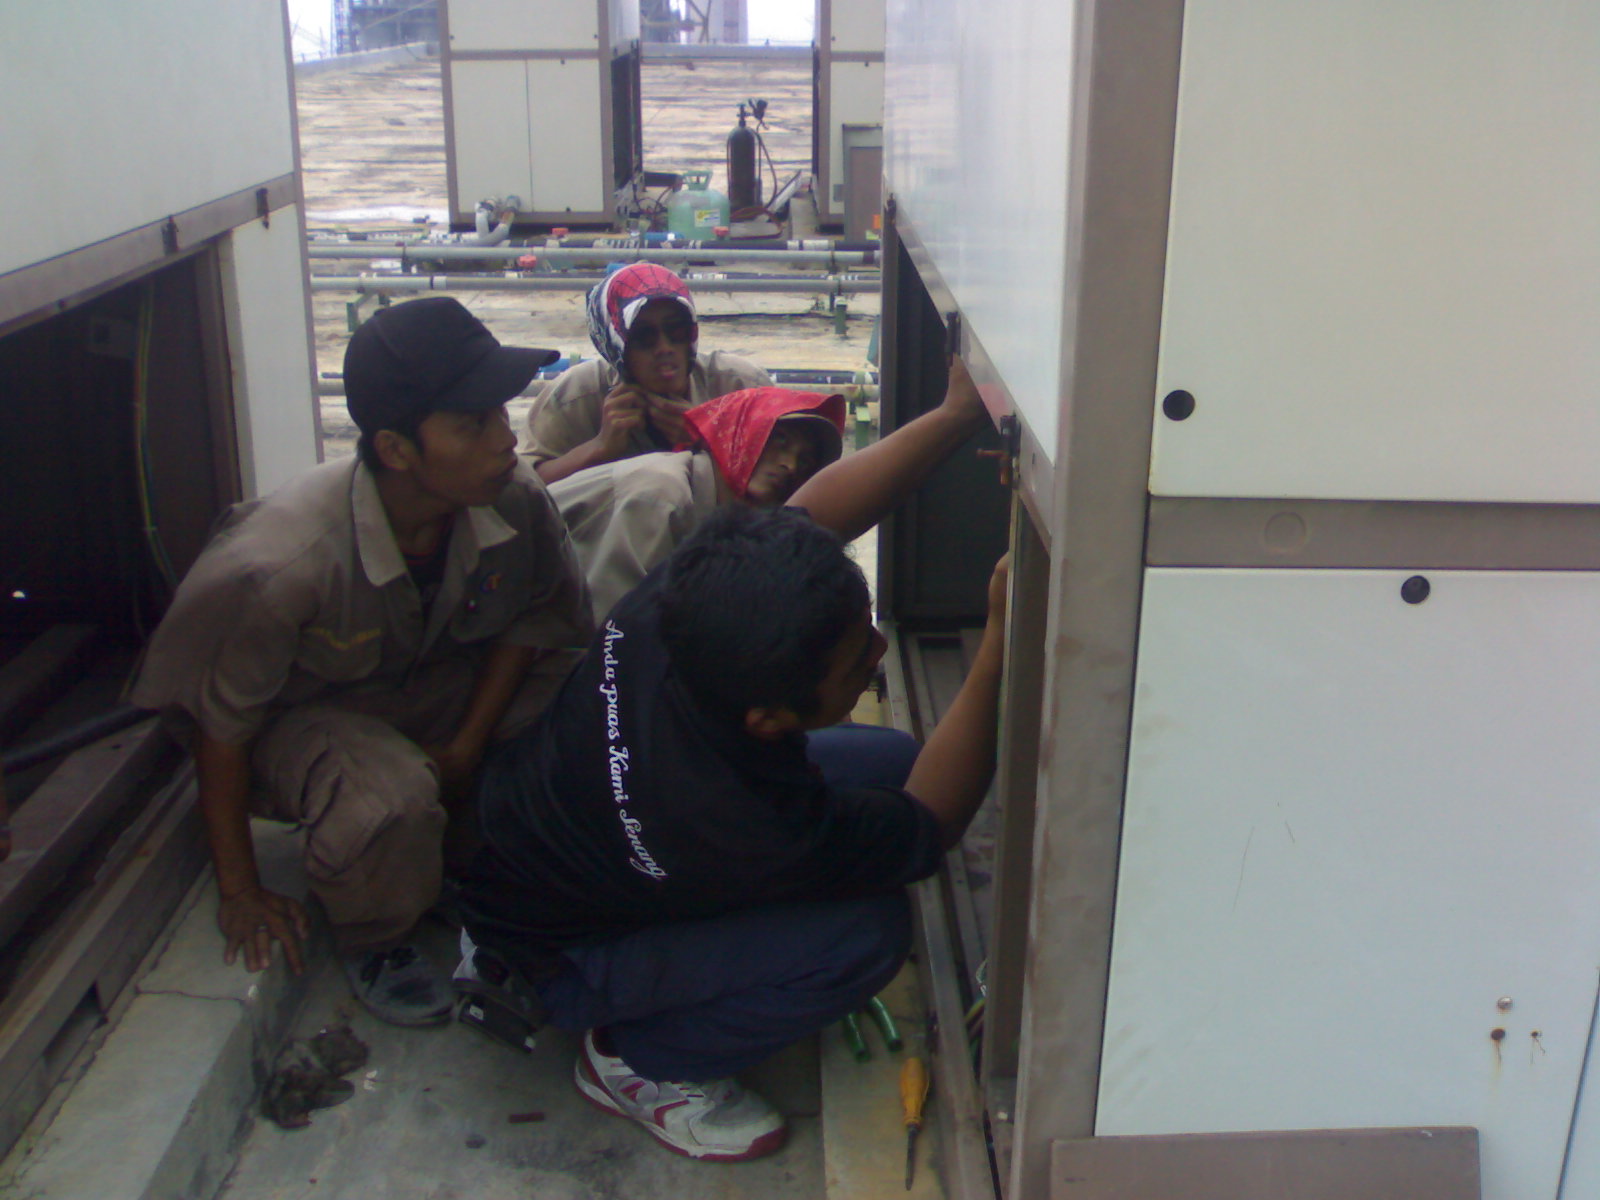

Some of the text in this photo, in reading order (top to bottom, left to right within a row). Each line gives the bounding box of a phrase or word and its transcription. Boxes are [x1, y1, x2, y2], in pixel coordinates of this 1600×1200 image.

[604, 619, 625, 681] Anda
[609, 745, 629, 803] Kami
[619, 808, 668, 881] Senang
